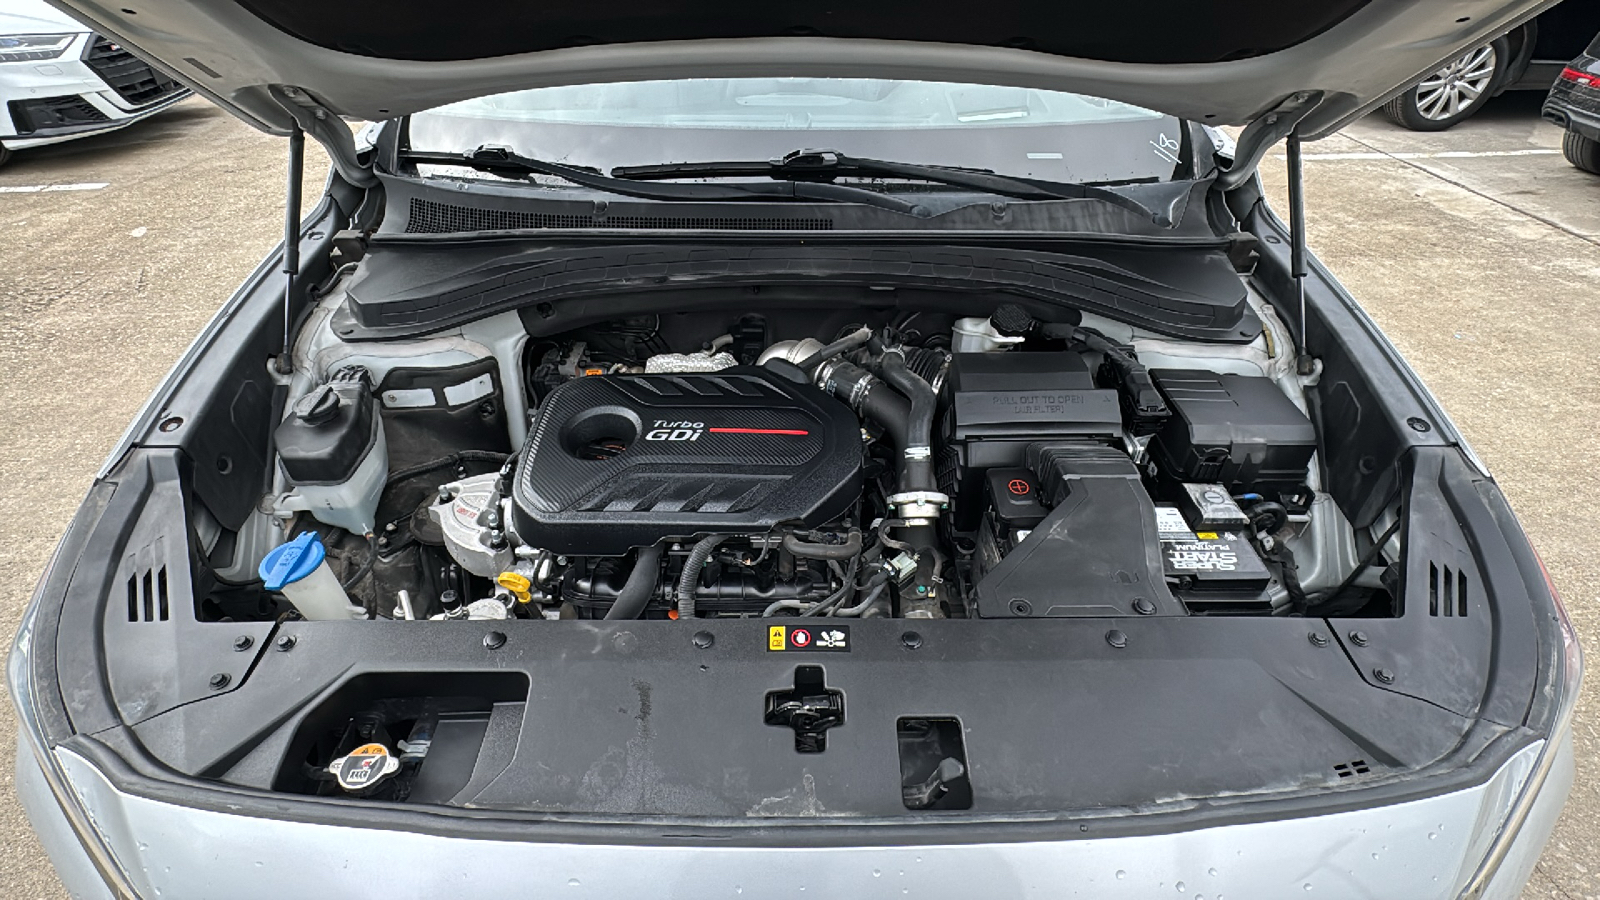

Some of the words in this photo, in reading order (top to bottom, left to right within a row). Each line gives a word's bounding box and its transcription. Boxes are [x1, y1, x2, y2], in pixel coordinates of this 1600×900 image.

[992, 396, 1018, 405] PULL
[1019, 395, 1040, 404] OUT
[1041, 395, 1057, 404] TO
[1058, 395, 1085, 404] OPEN
[653, 419, 705, 428] Turbo
[645, 429, 703, 441] GDi
[1169, 551, 1238, 562] START
[1174, 560, 1236, 571] SUPER
